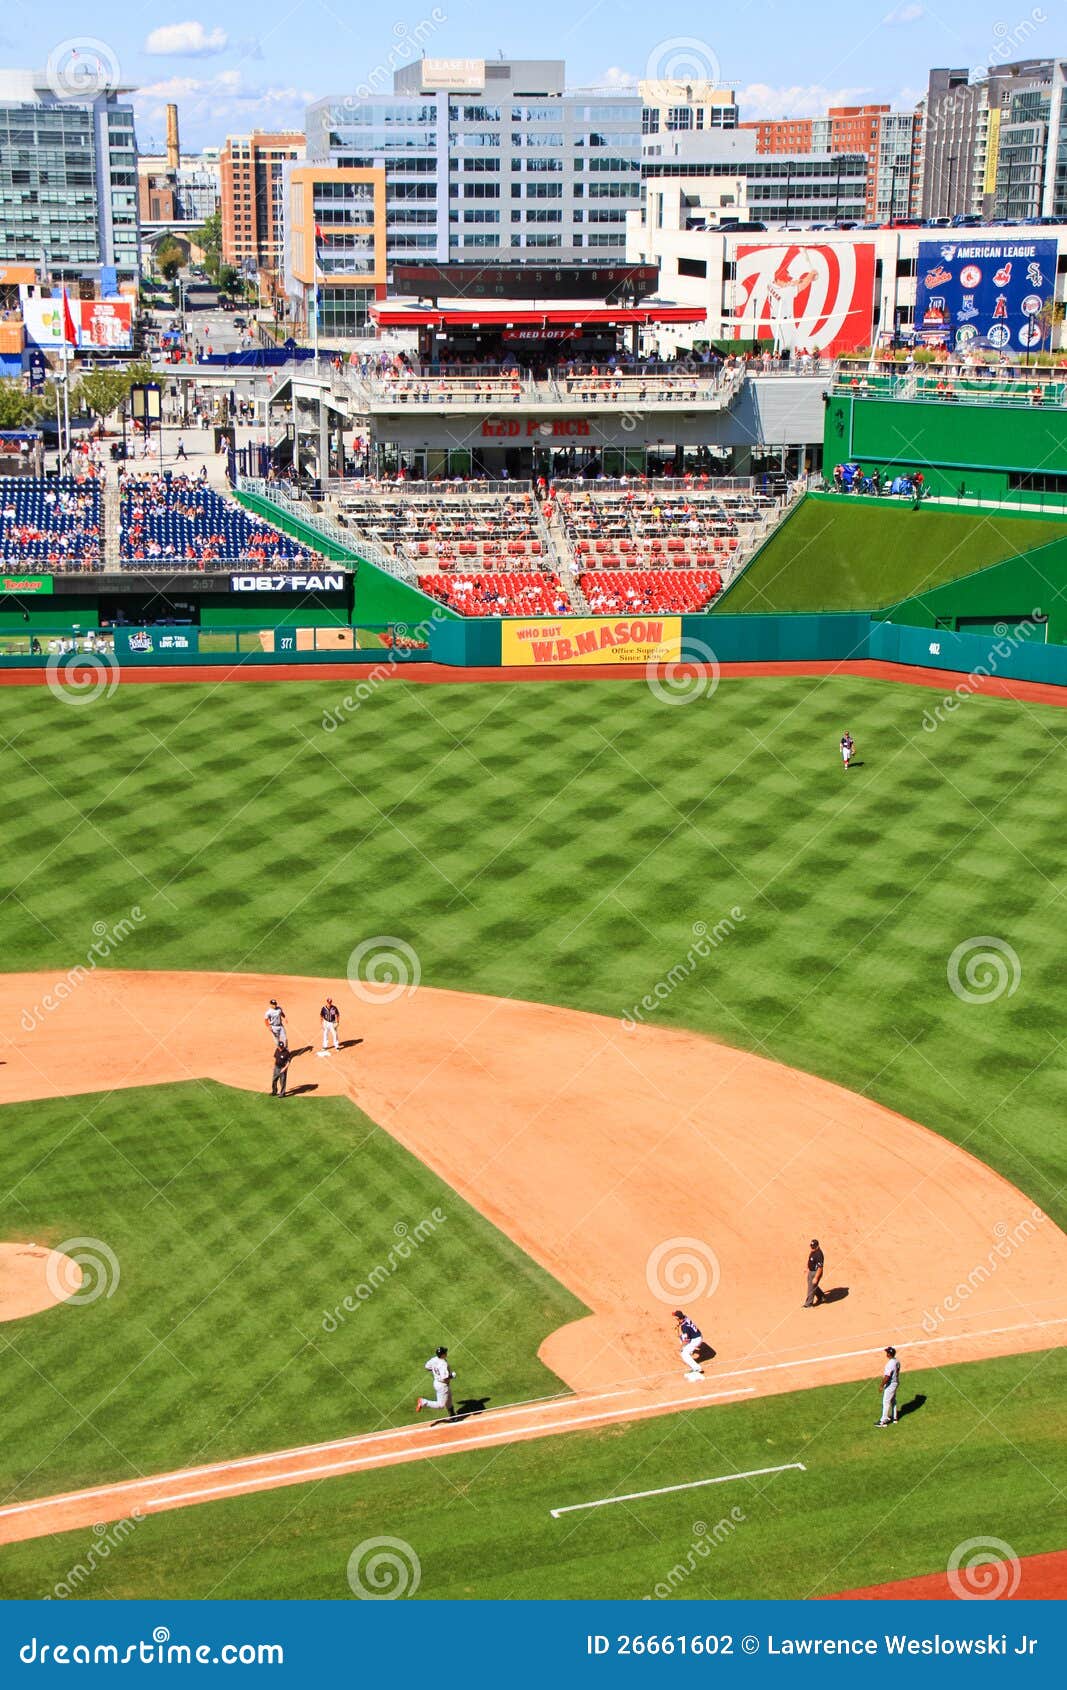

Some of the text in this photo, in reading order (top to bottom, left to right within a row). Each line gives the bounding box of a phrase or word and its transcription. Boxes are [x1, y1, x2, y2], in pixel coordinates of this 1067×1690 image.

[957, 246, 1036, 258] AMERICAN LEAGUE
[481, 419, 519, 436] RED
[3, 579, 42, 589] Teeter
[231, 576, 286, 591] 106.7
[291, 576, 344, 590] FAN
[517, 625, 562, 640] WHO BUY
[280, 637, 293, 650] 377
[531, 621, 664, 663] W.B.MASON
[929, 642, 940, 655] 402
